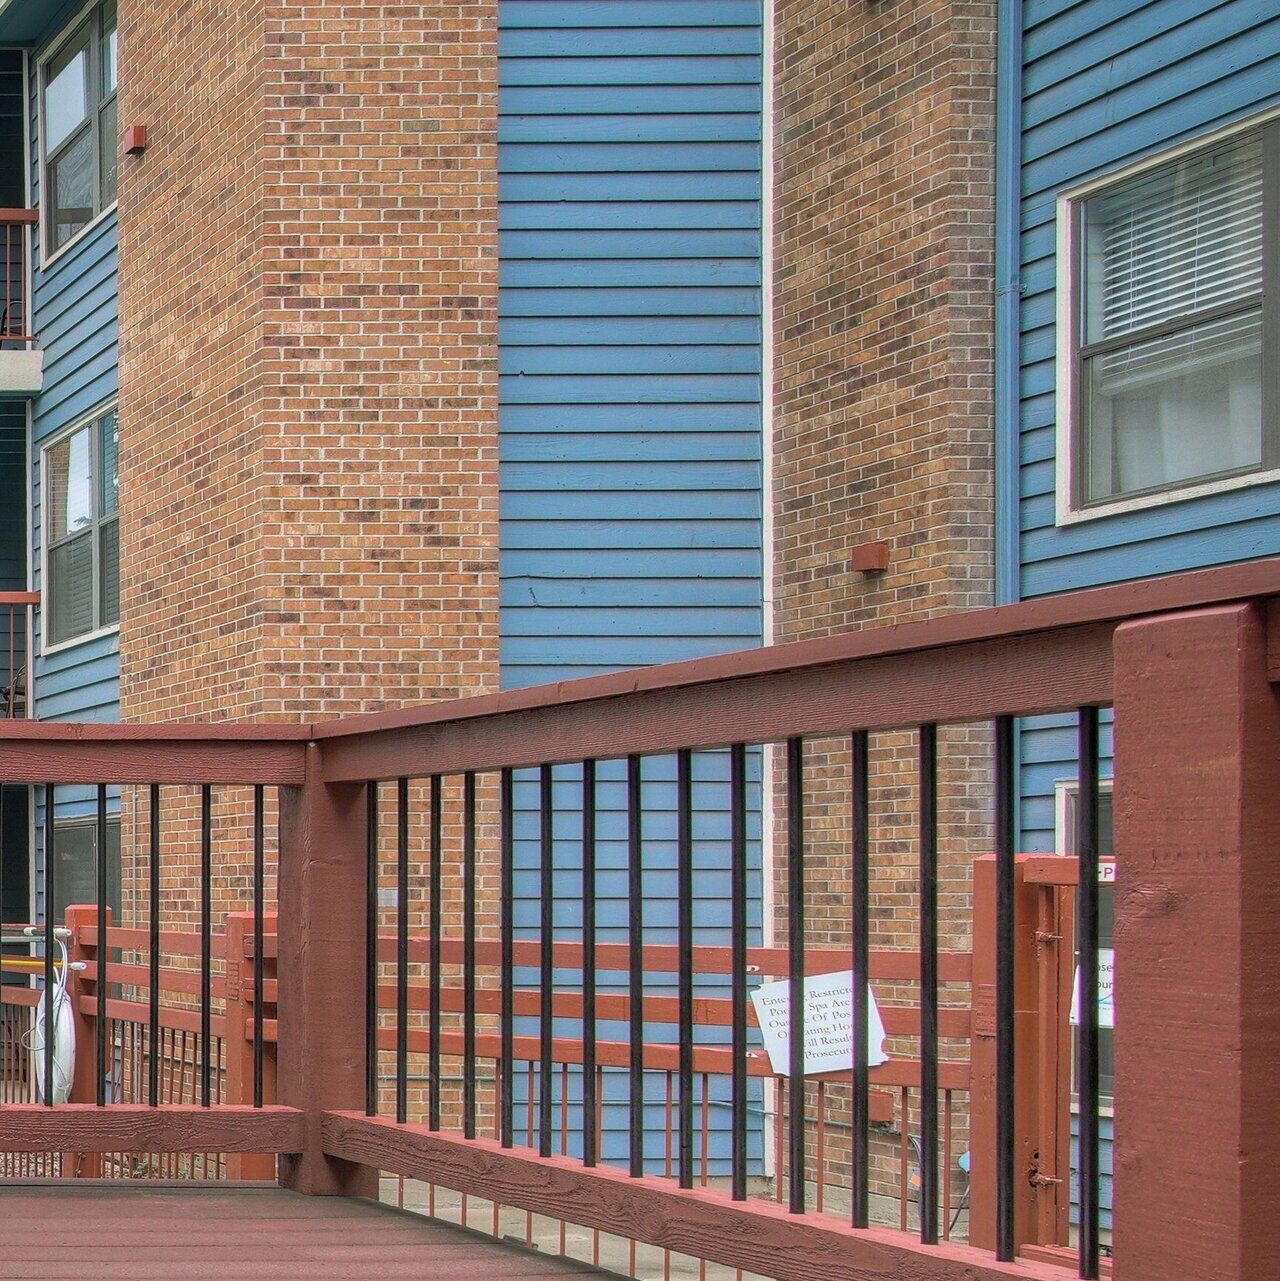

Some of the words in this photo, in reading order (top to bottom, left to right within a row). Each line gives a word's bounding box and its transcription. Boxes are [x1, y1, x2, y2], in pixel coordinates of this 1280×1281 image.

[809, 1002, 828, 1013] Spa
[832, 998, 851, 1008] Are
[812, 1011, 828, 1022] Of
